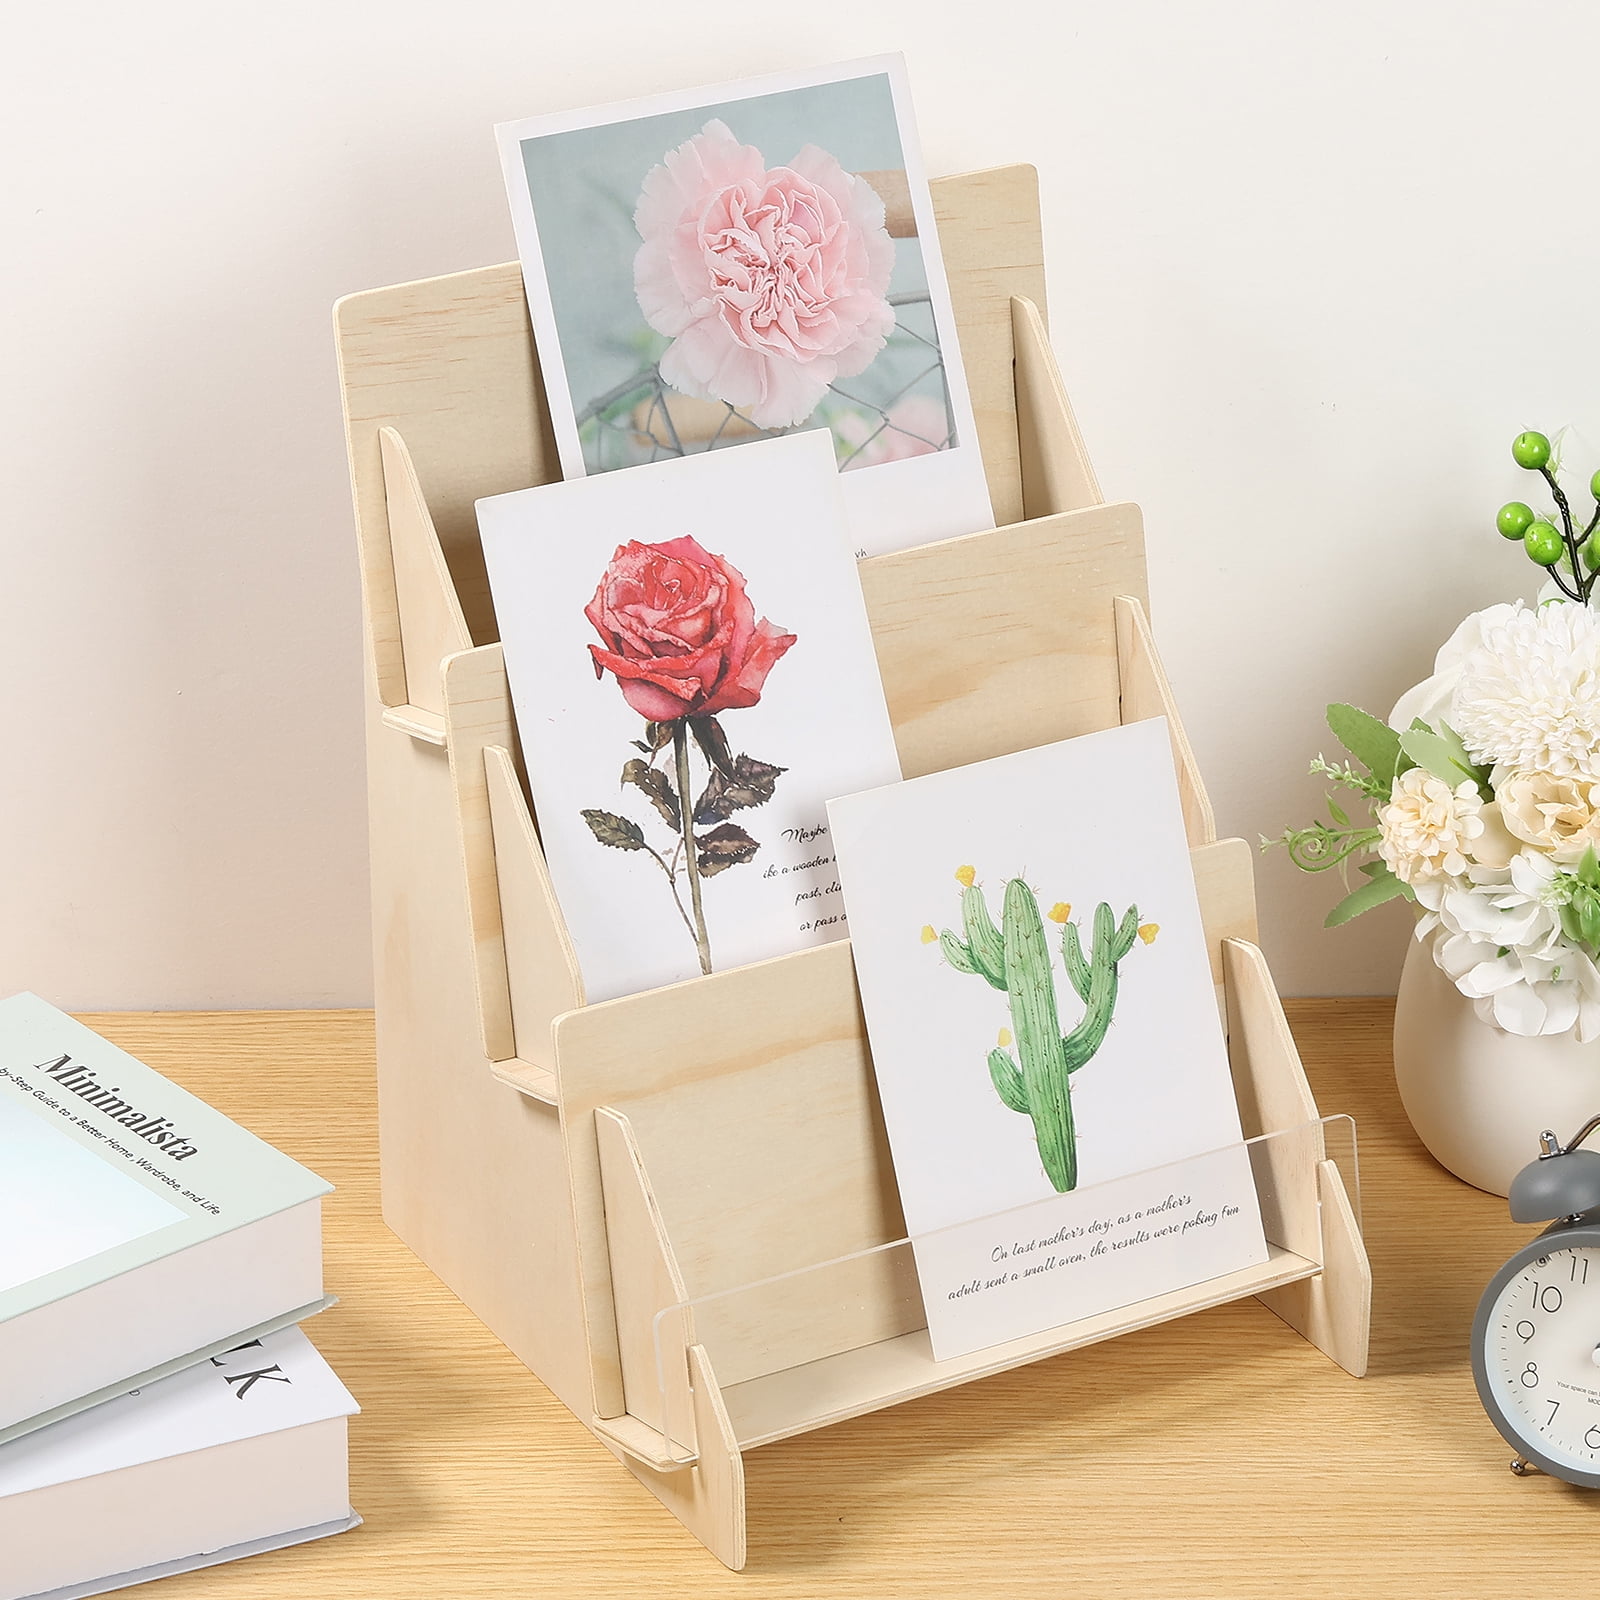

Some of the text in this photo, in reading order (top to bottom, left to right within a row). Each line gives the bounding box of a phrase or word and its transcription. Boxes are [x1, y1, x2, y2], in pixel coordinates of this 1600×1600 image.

[780, 824, 828, 843] Maybe
[792, 855, 829, 872] wooden
[794, 887, 822, 906] past,
[813, 915, 838, 932] pass
[32, 1053, 199, 1161] Minimalista
[32, 1090, 60, 1110] Guide
[58, 1108, 71, 1117] to
[76, 1119, 107, 1139] Better
[135, 1157, 181, 1191] Wardrobe,
[181, 1189, 204, 1203] and
[200, 1200, 221, 1215] Life
[991, 1194, 1192, 1263] On last mother's day, as a mother's
[948, 1279, 982, 1300] adult
[984, 1272, 1009, 1289] sent
[1010, 1272, 1019, 1281] a
[1023, 1256, 1056, 1278] small
[1058, 1252, 1087, 1267] oven,
[1090, 1240, 1108, 1257] the
[1112, 1230, 1150, 1251] results
[1153, 1224, 1180, 1239] were
[1181, 1209, 1218, 1236] poking
[1571, 1255, 1589, 1285] 11
[1532, 1281, 1563, 1314] 10
[1516, 1320, 1536, 1345] 9
[1520, 1361, 1539, 1389] 8
[1546, 1399, 1560, 1426] 7
